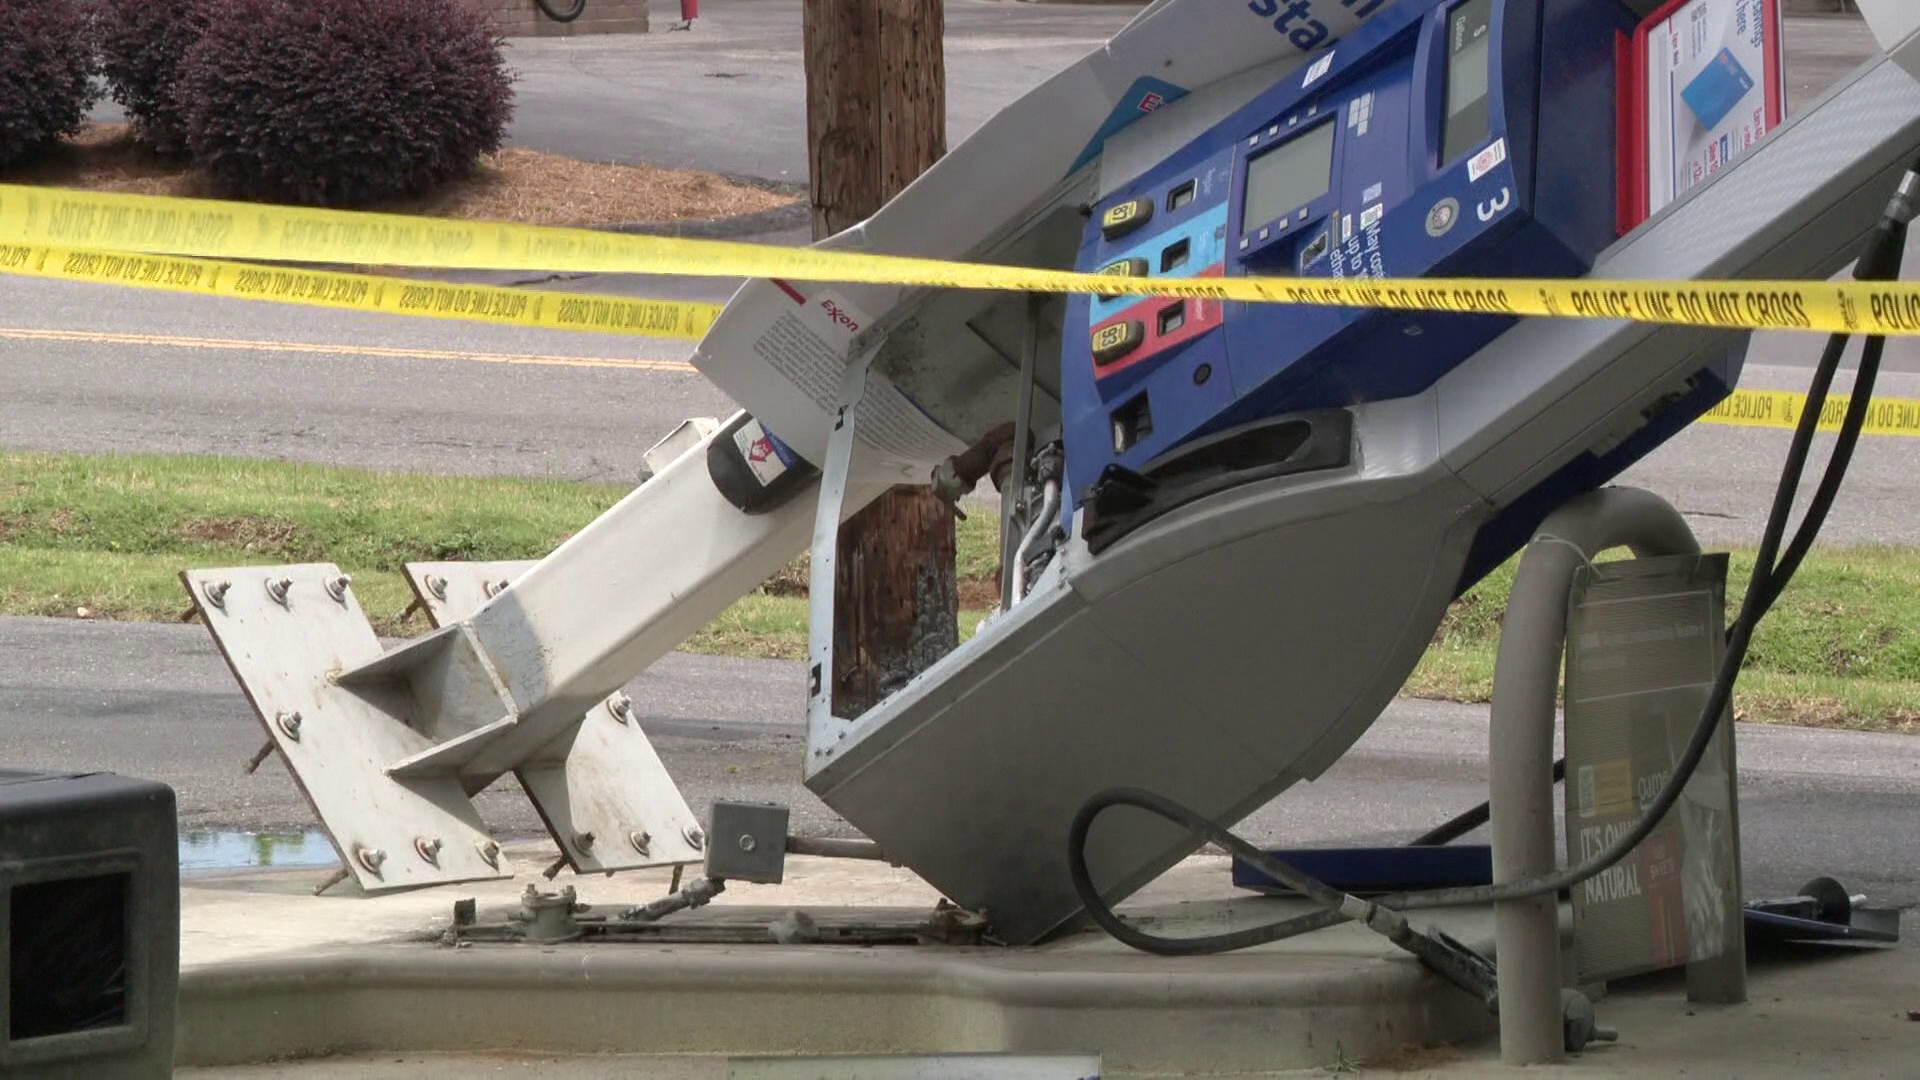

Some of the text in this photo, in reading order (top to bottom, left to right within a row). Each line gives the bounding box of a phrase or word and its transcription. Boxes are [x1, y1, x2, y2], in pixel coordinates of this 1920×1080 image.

[1736, 3, 1749, 36] here
[1112, 205, 1129, 221] 87
[1477, 186, 1510, 221] 3
[1345, 235, 1360, 255] up
[1365, 221, 1381, 253] May
[1351, 251, 1364, 270] to
[822, 299, 859, 332] Exxon
[1571, 290, 1811, 328] POLICE LINE DO NOT CROSS
[1870, 293, 1920, 329] POLIC
[1102, 327, 1118, 347] 93
[1586, 863, 1641, 904] NATURAL
